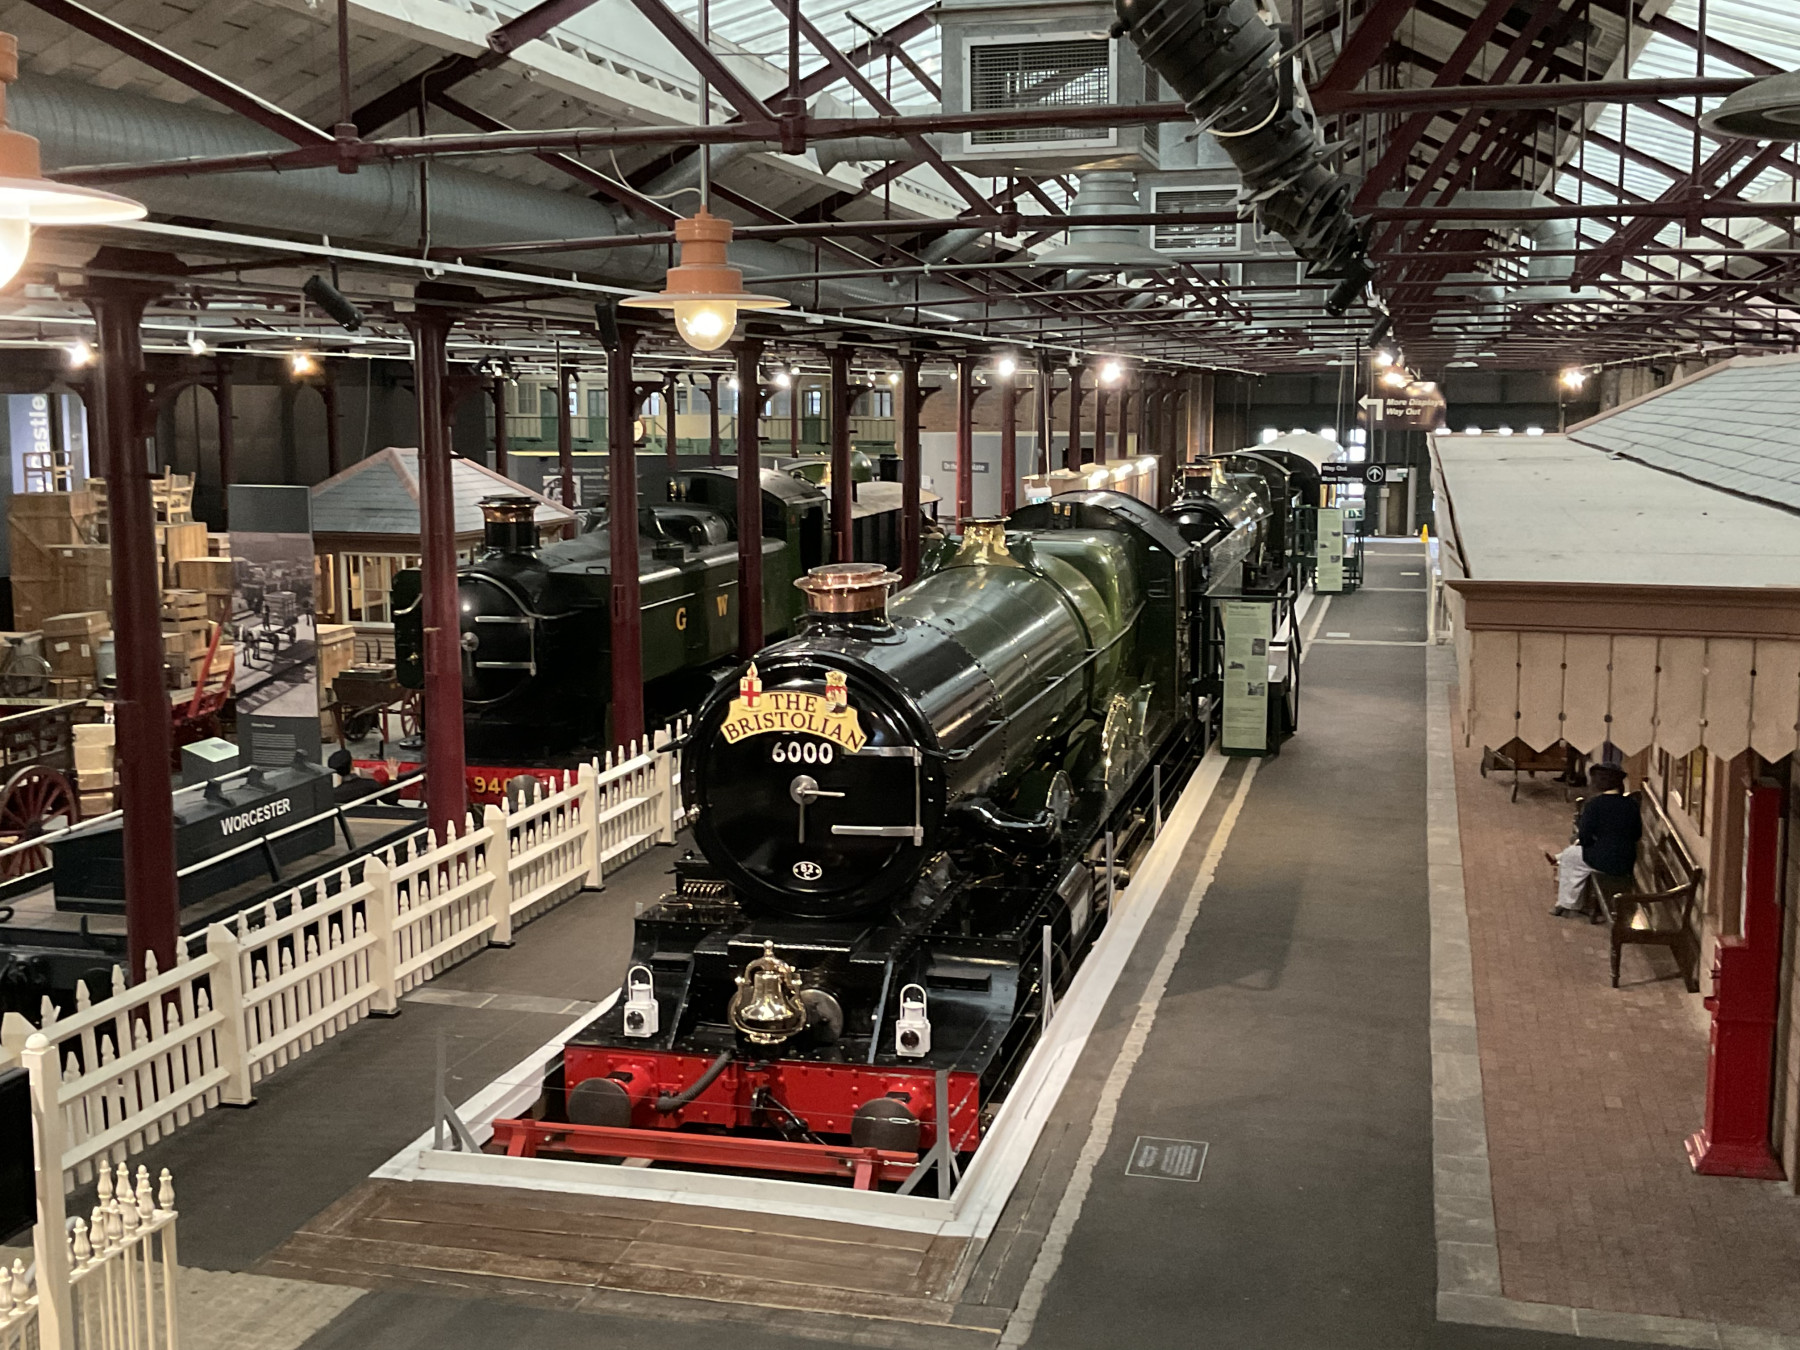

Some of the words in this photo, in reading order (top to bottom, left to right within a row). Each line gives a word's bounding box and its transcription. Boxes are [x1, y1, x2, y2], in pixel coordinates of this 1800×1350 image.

[1386, 398, 1407, 406] More
[1408, 398, 1445, 408] Displays
[1386, 407, 1404, 417] Way
[1405, 407, 1422, 416] Out
[675, 607, 687, 631] G
[716, 594, 729, 617] W
[769, 693, 818, 713] THE
[724, 711, 865, 750] BRISTOLIAN
[771, 741, 834, 765] 6000
[220, 797, 292, 836] WORCESTER
[800, 863, 814, 874] 82
